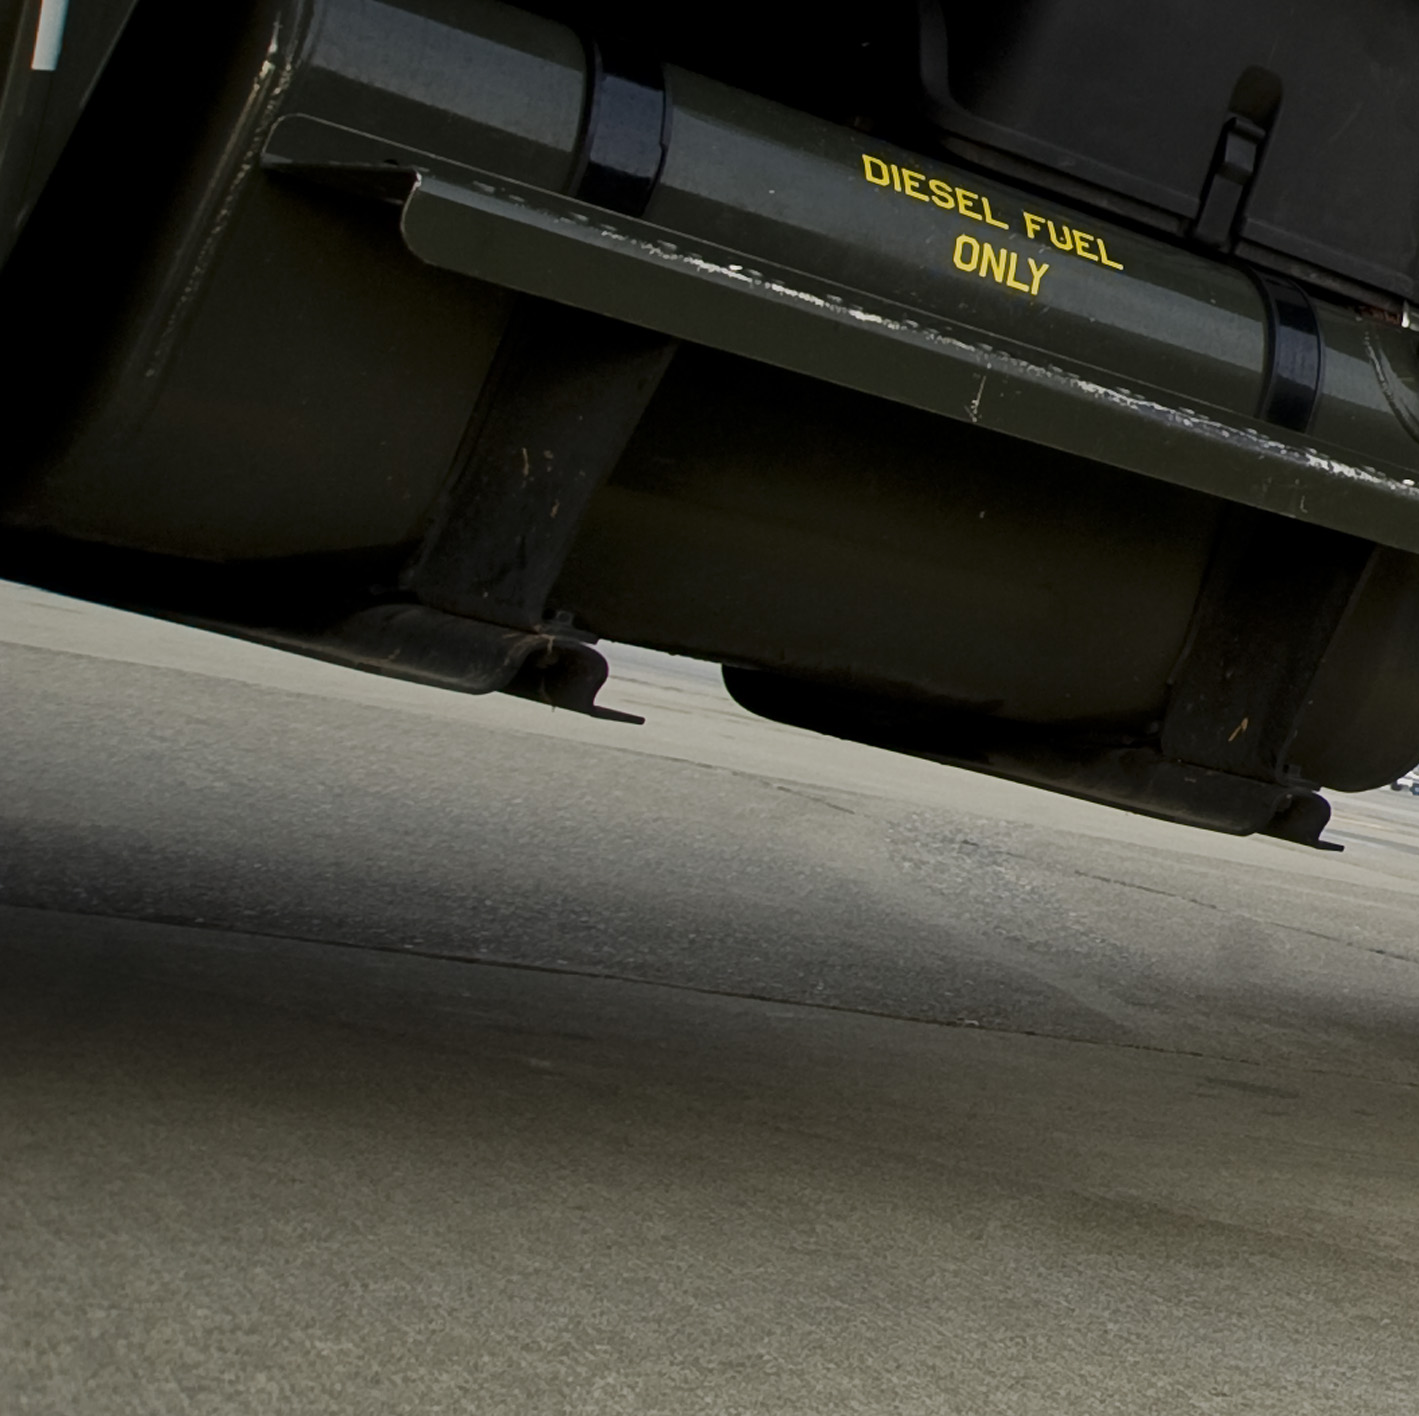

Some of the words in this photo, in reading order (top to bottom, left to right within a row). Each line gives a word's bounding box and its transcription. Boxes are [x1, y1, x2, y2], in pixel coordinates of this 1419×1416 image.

[861, 153, 1010, 231] DIESEL
[1022, 210, 1124, 271] FUEL
[952, 233, 1050, 296] ONLY
